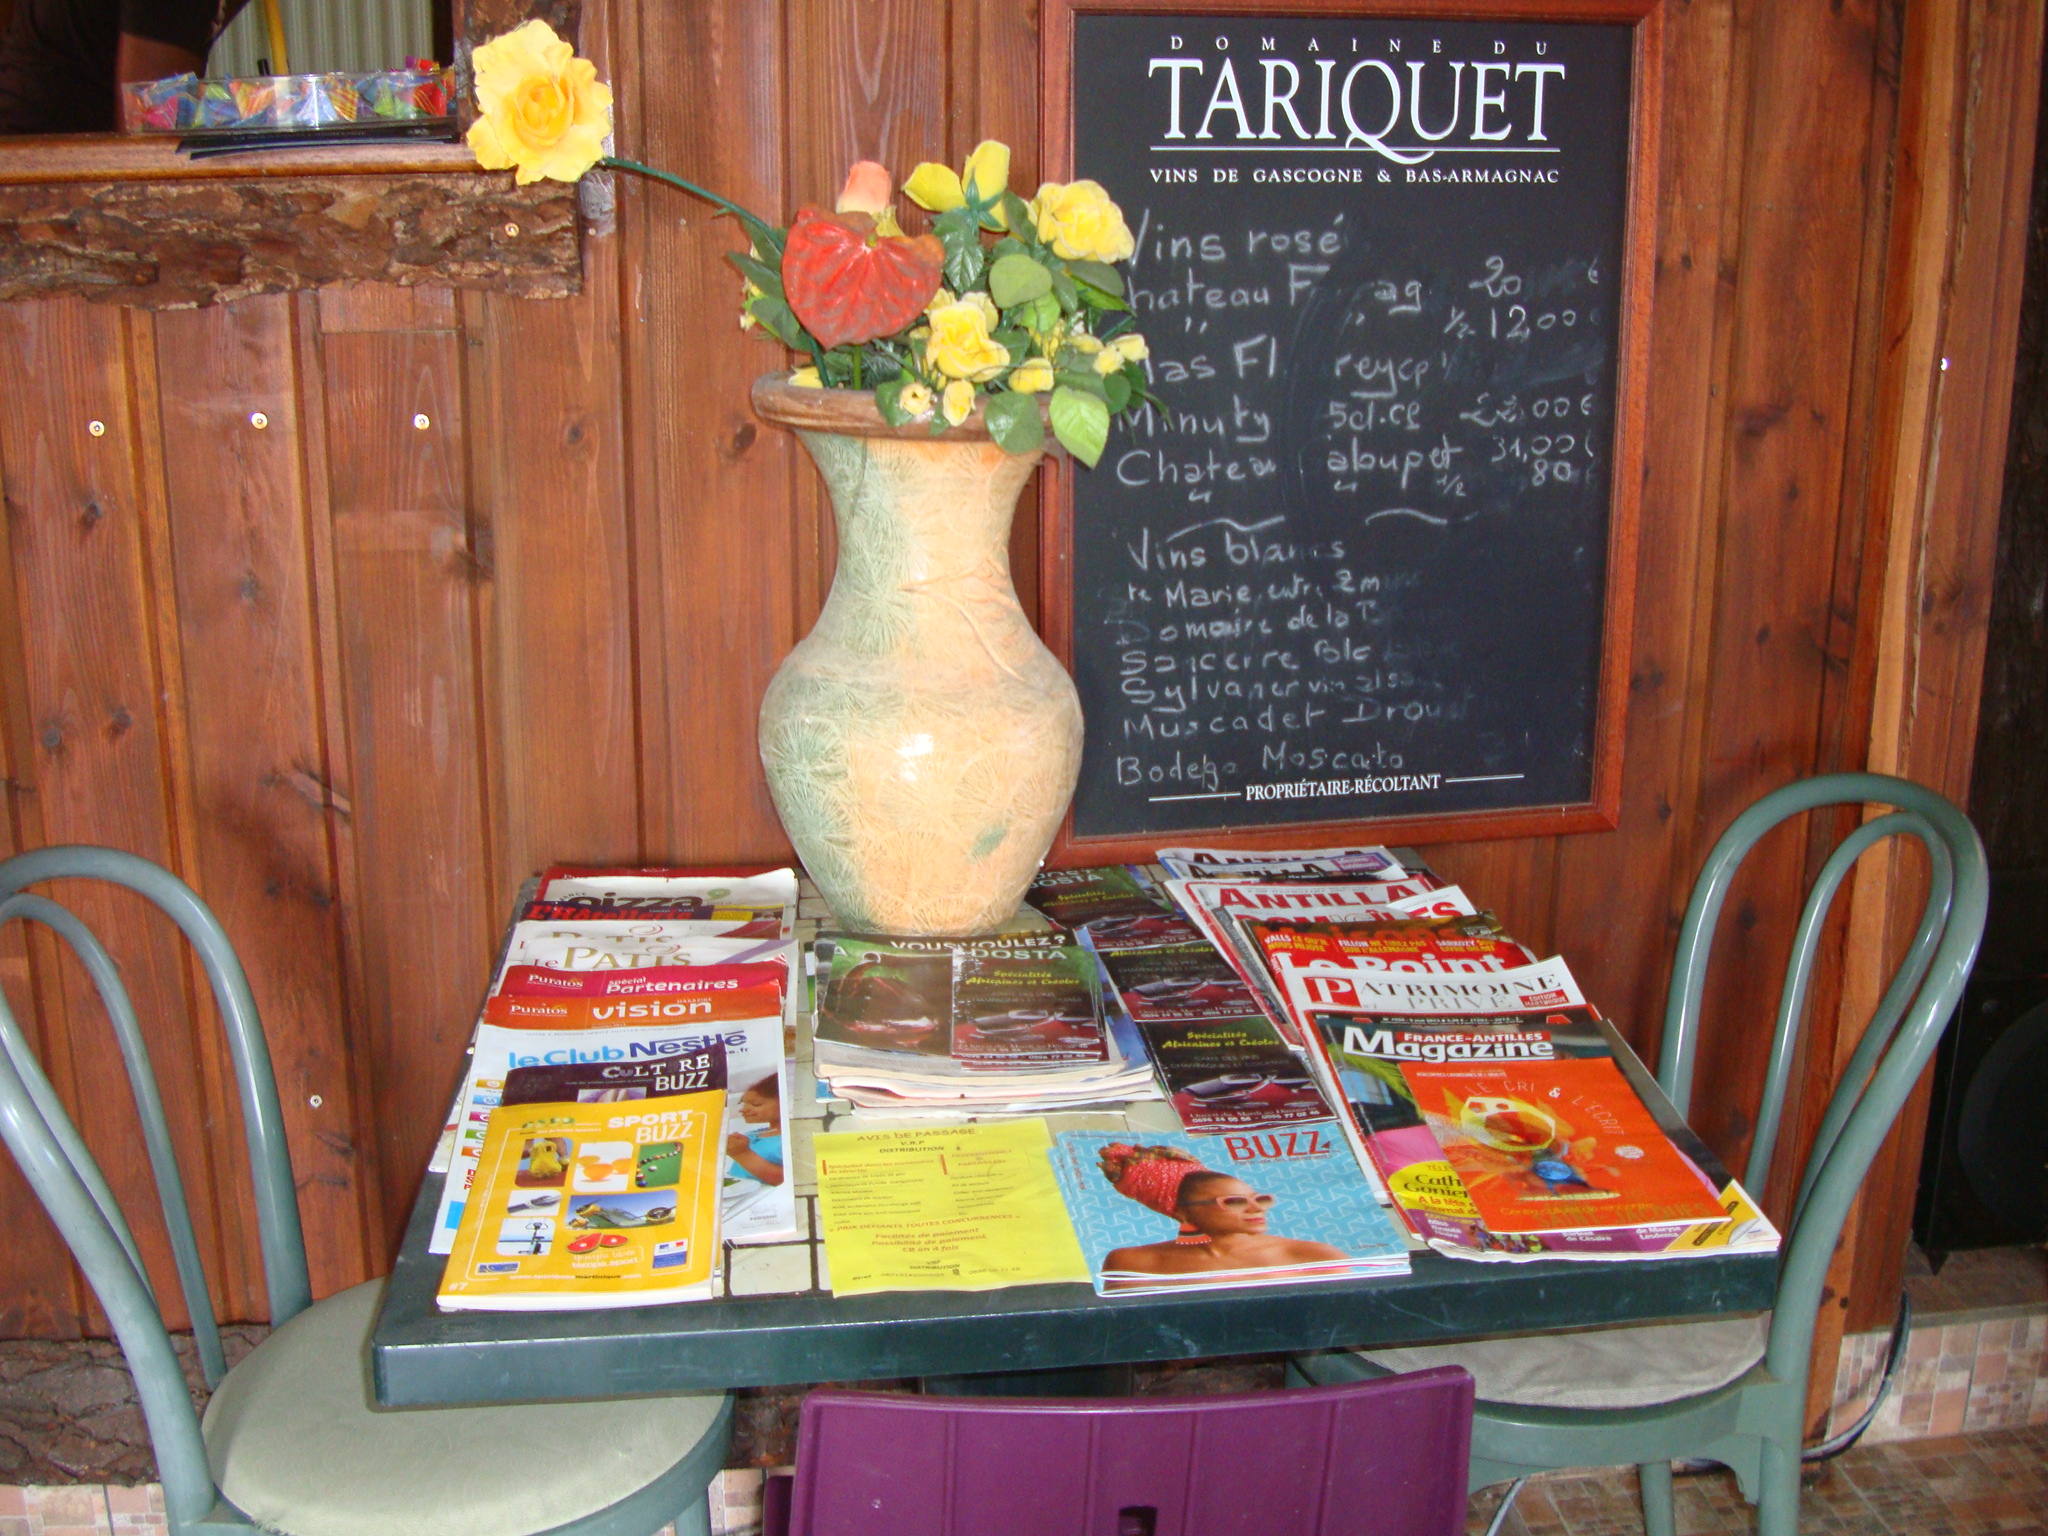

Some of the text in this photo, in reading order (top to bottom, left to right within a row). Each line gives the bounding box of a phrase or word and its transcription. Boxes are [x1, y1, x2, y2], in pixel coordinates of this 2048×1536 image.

[1170, 36, 1548, 55] DOMAINE DU
[1149, 57, 1566, 164] TARIQUET
[1150, 168, 1560, 184] VINS DE GASCOGNE & BAS-ARMAGNAC
[1249, 213, 1344, 254] rosé
[1127, 267, 1270, 311] hateau
[1127, 527, 1345, 571] Vins blas
[1164, 580, 1251, 609] Marie
[1122, 702, 1326, 741] Muscadet
[1261, 740, 1404, 771] Moscato
[1246, 773, 1442, 802] PROPRIÉTAIRE-RÉCOLTANT
[1219, 885, 1418, 909] ANTILLA
[1347, 953, 1506, 974] Point
[527, 973, 584, 988] Puratos
[606, 979, 739, 994] Partenaires
[1315, 973, 1563, 1004] PATRIMOINE
[509, 1003, 568, 1016] Puratos
[592, 1000, 712, 1020] vision
[629, 1030, 748, 1058] Nestlé
[1187, 1032, 1247, 1040] Spécialités
[1343, 1026, 1556, 1063] Magazine
[1404, 1032, 1544, 1043] FRANCE-ANTILLES
[655, 1071, 708, 1091] BUZZ
[1503, 1081, 1536, 1093] CRI
[1548, 1087, 1562, 1098] &
[607, 1110, 693, 1129] SPORT
[635, 1122, 694, 1144] BUZZ
[857, 1133, 891, 1141] AVIS
[915, 1128, 976, 1137] PASSAGE
[1224, 1130, 1330, 1161] BUZZ
[1415, 1174, 1462, 1187] Cath
